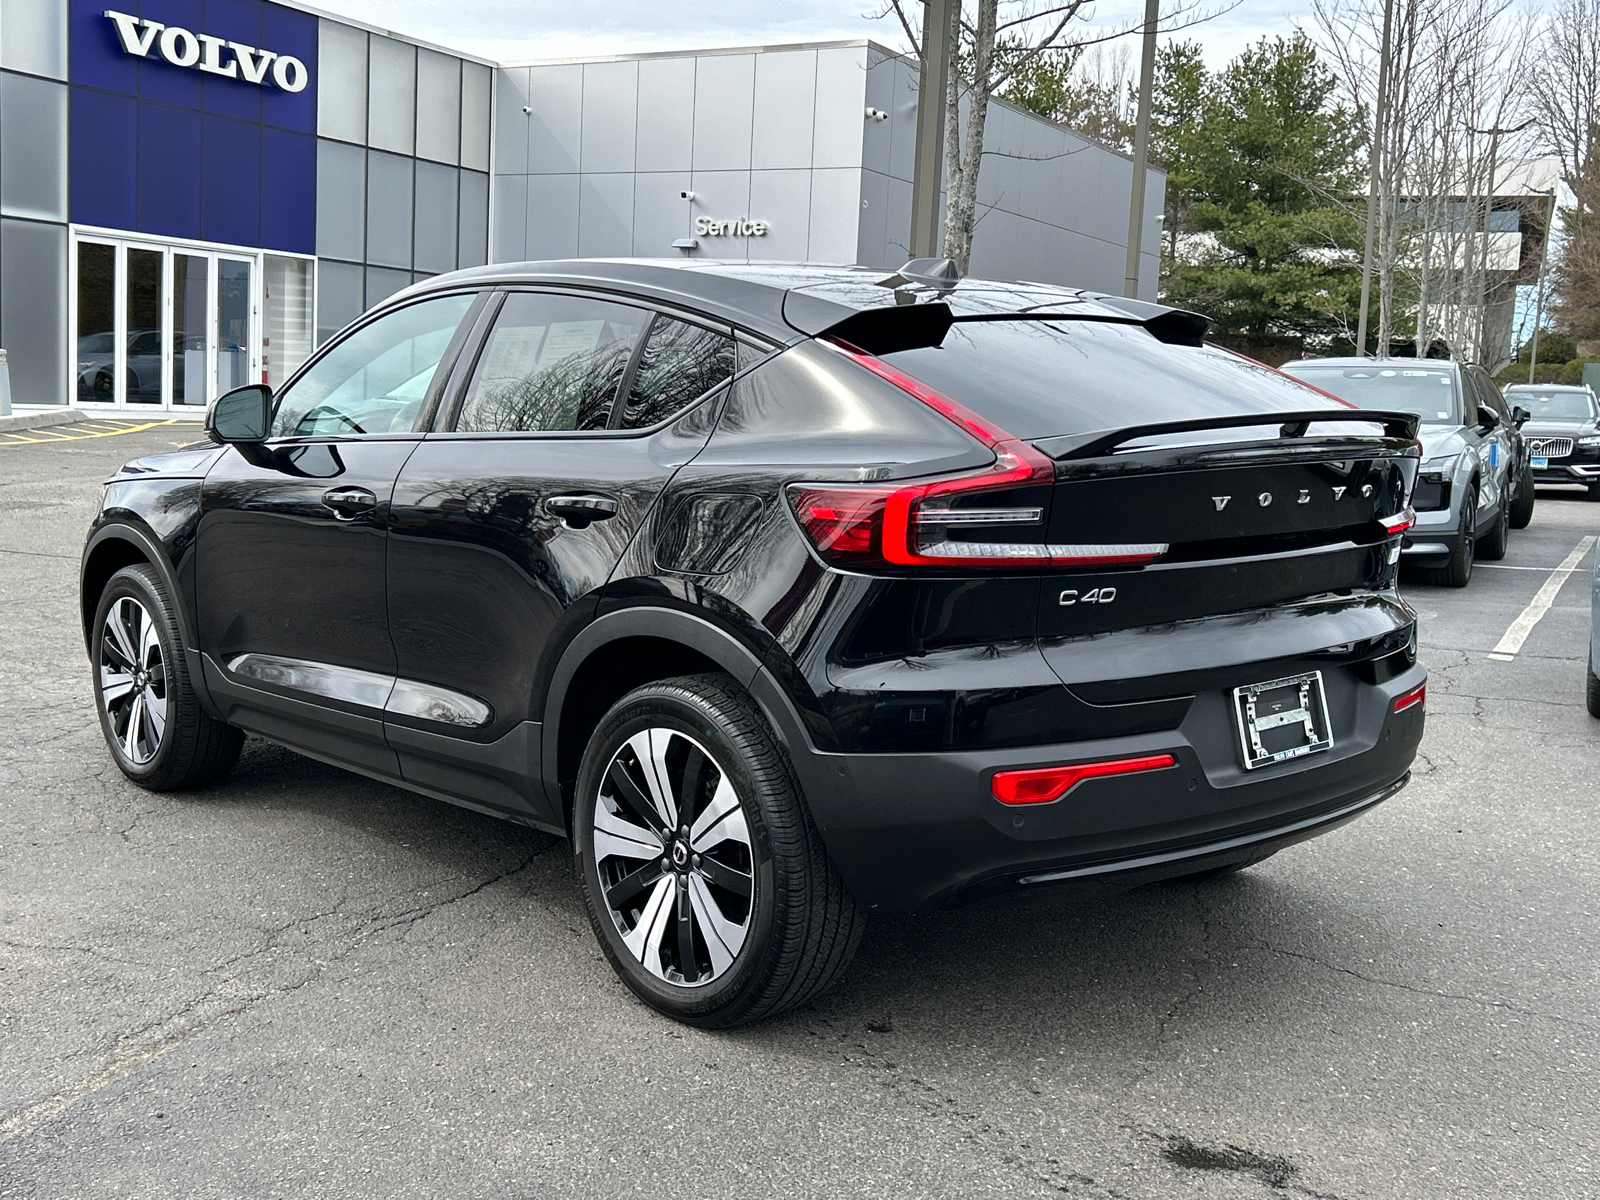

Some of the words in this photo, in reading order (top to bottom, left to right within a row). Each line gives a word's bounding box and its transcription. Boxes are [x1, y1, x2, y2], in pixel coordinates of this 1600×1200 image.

[103, 10, 308, 93] VOLVO
[695, 215, 767, 236] Service
[1211, 484, 1374, 512] VOLVO
[1059, 587, 1116, 606] C40
